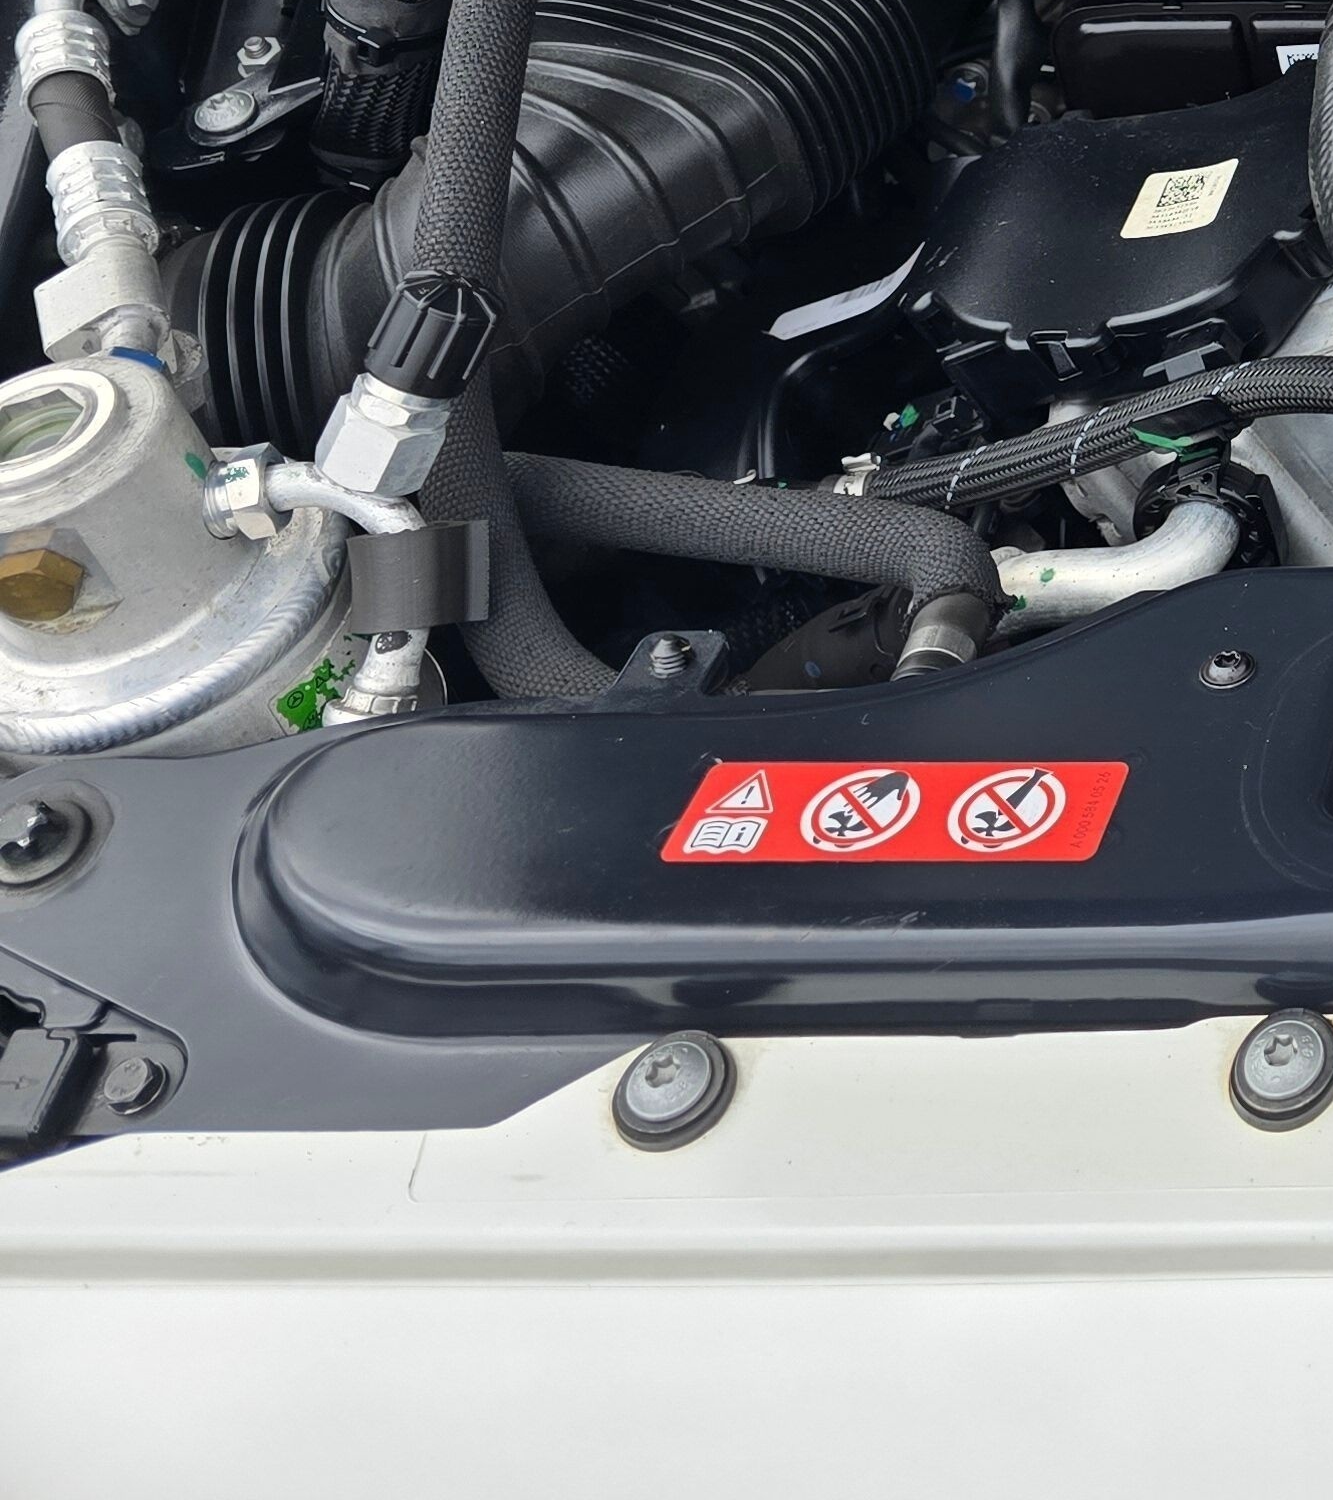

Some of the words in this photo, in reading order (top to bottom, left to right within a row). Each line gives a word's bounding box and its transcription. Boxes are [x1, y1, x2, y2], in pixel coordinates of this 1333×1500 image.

[1096, 771, 1112, 784] 26
[1090, 785, 1106, 798] 05
[1072, 820, 1092, 839] 000
[1069, 840, 1083, 849] A
